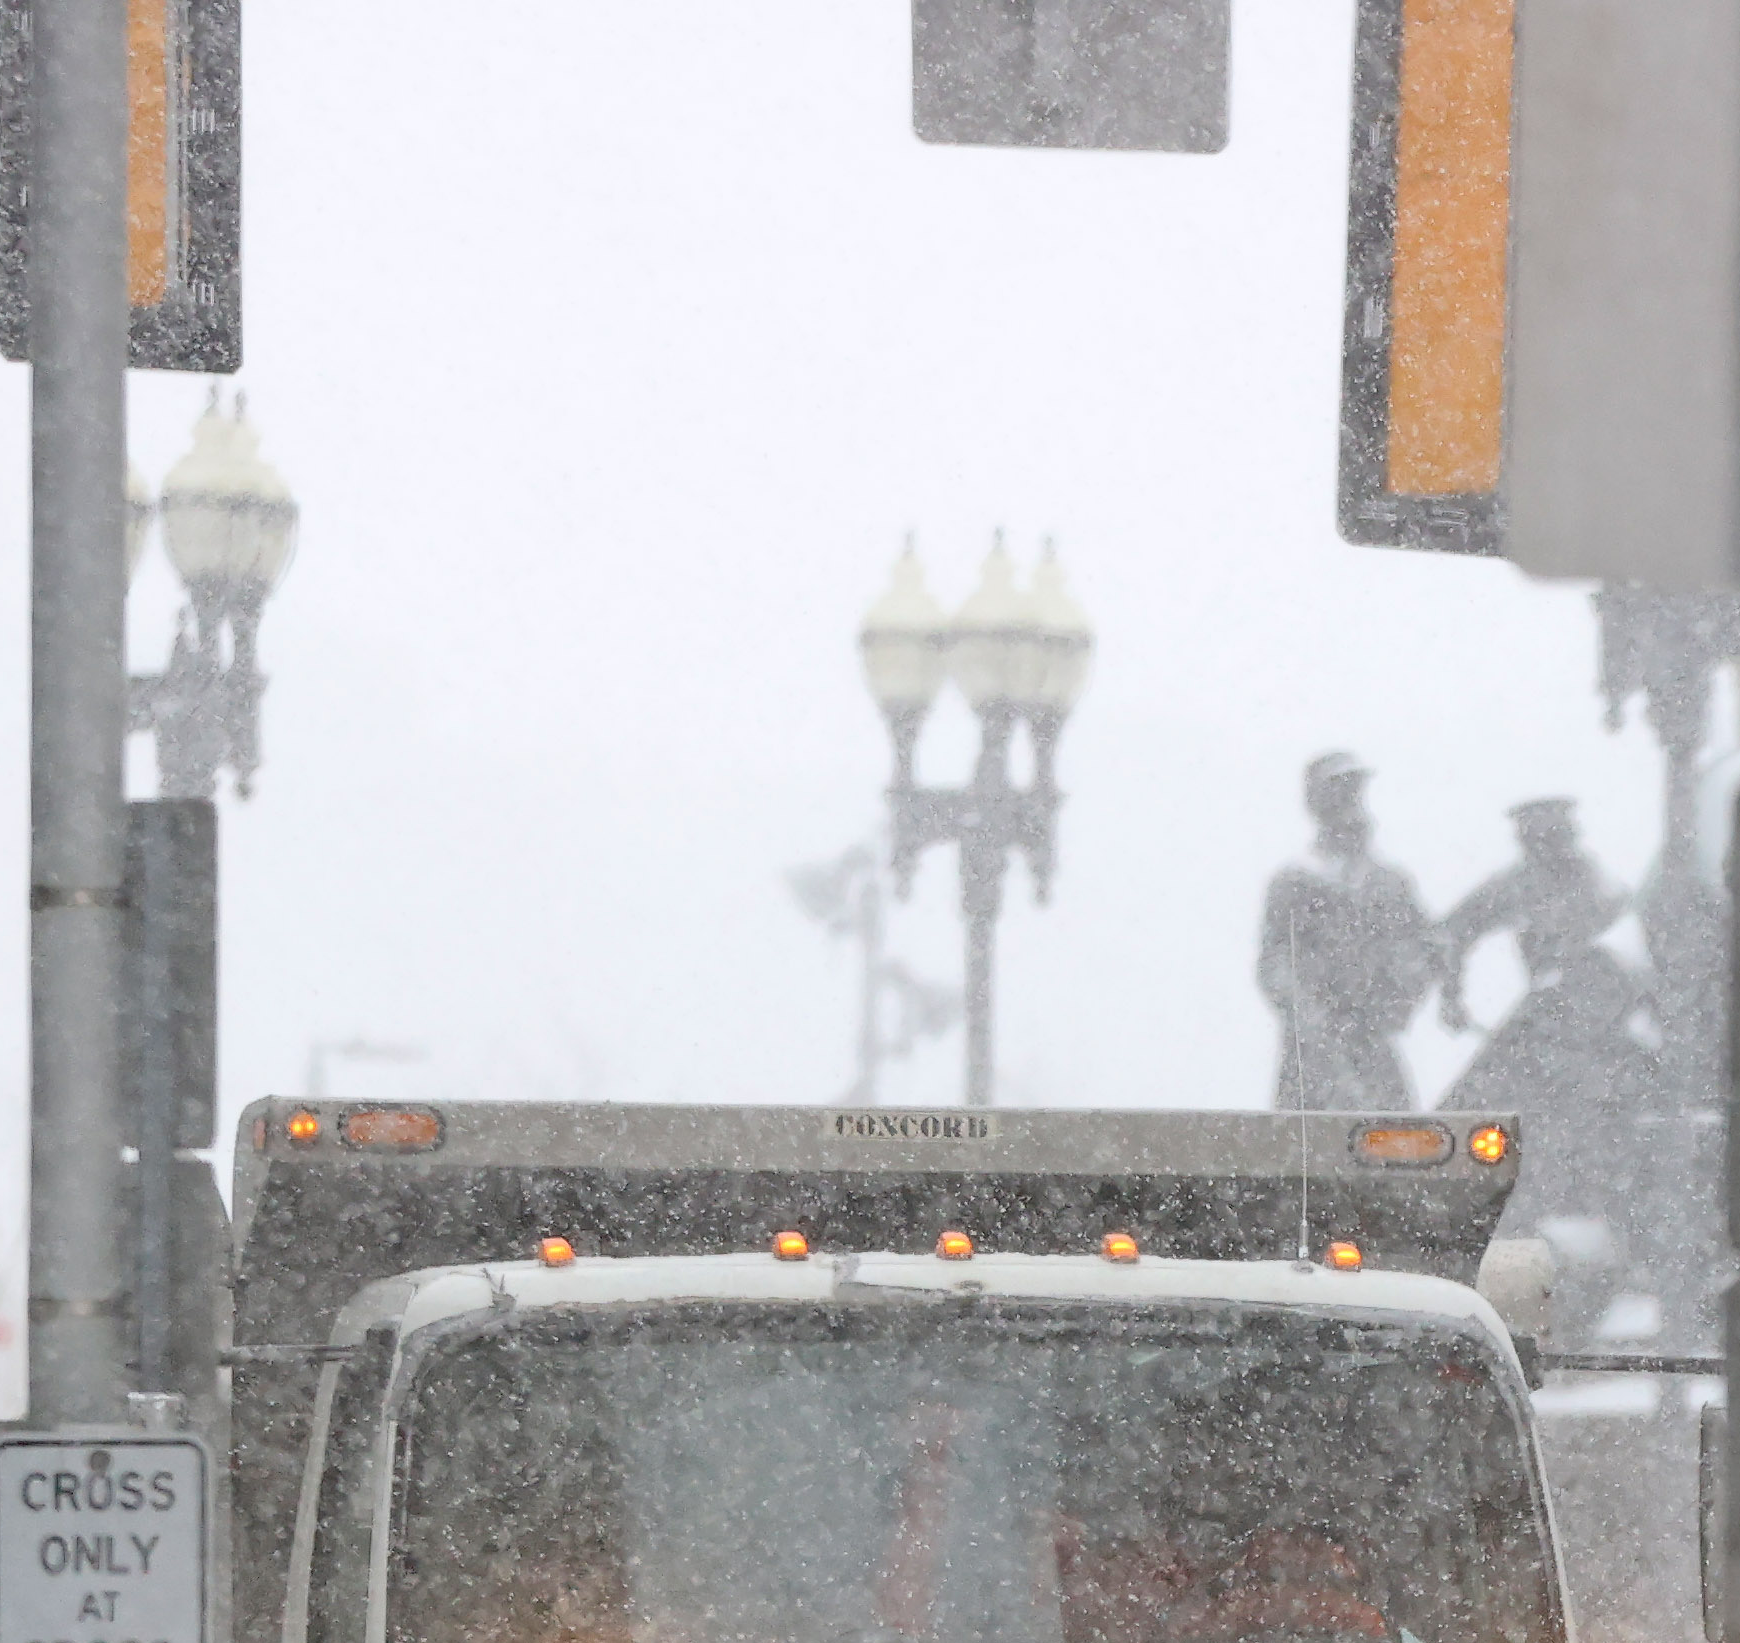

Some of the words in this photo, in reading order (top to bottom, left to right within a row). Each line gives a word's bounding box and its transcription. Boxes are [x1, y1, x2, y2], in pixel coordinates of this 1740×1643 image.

[836, 1114, 988, 1138] CONCORD
[22, 1470, 176, 1511] CROSS
[40, 1533, 159, 1574] ONLY
[77, 1590, 120, 1622] AT
